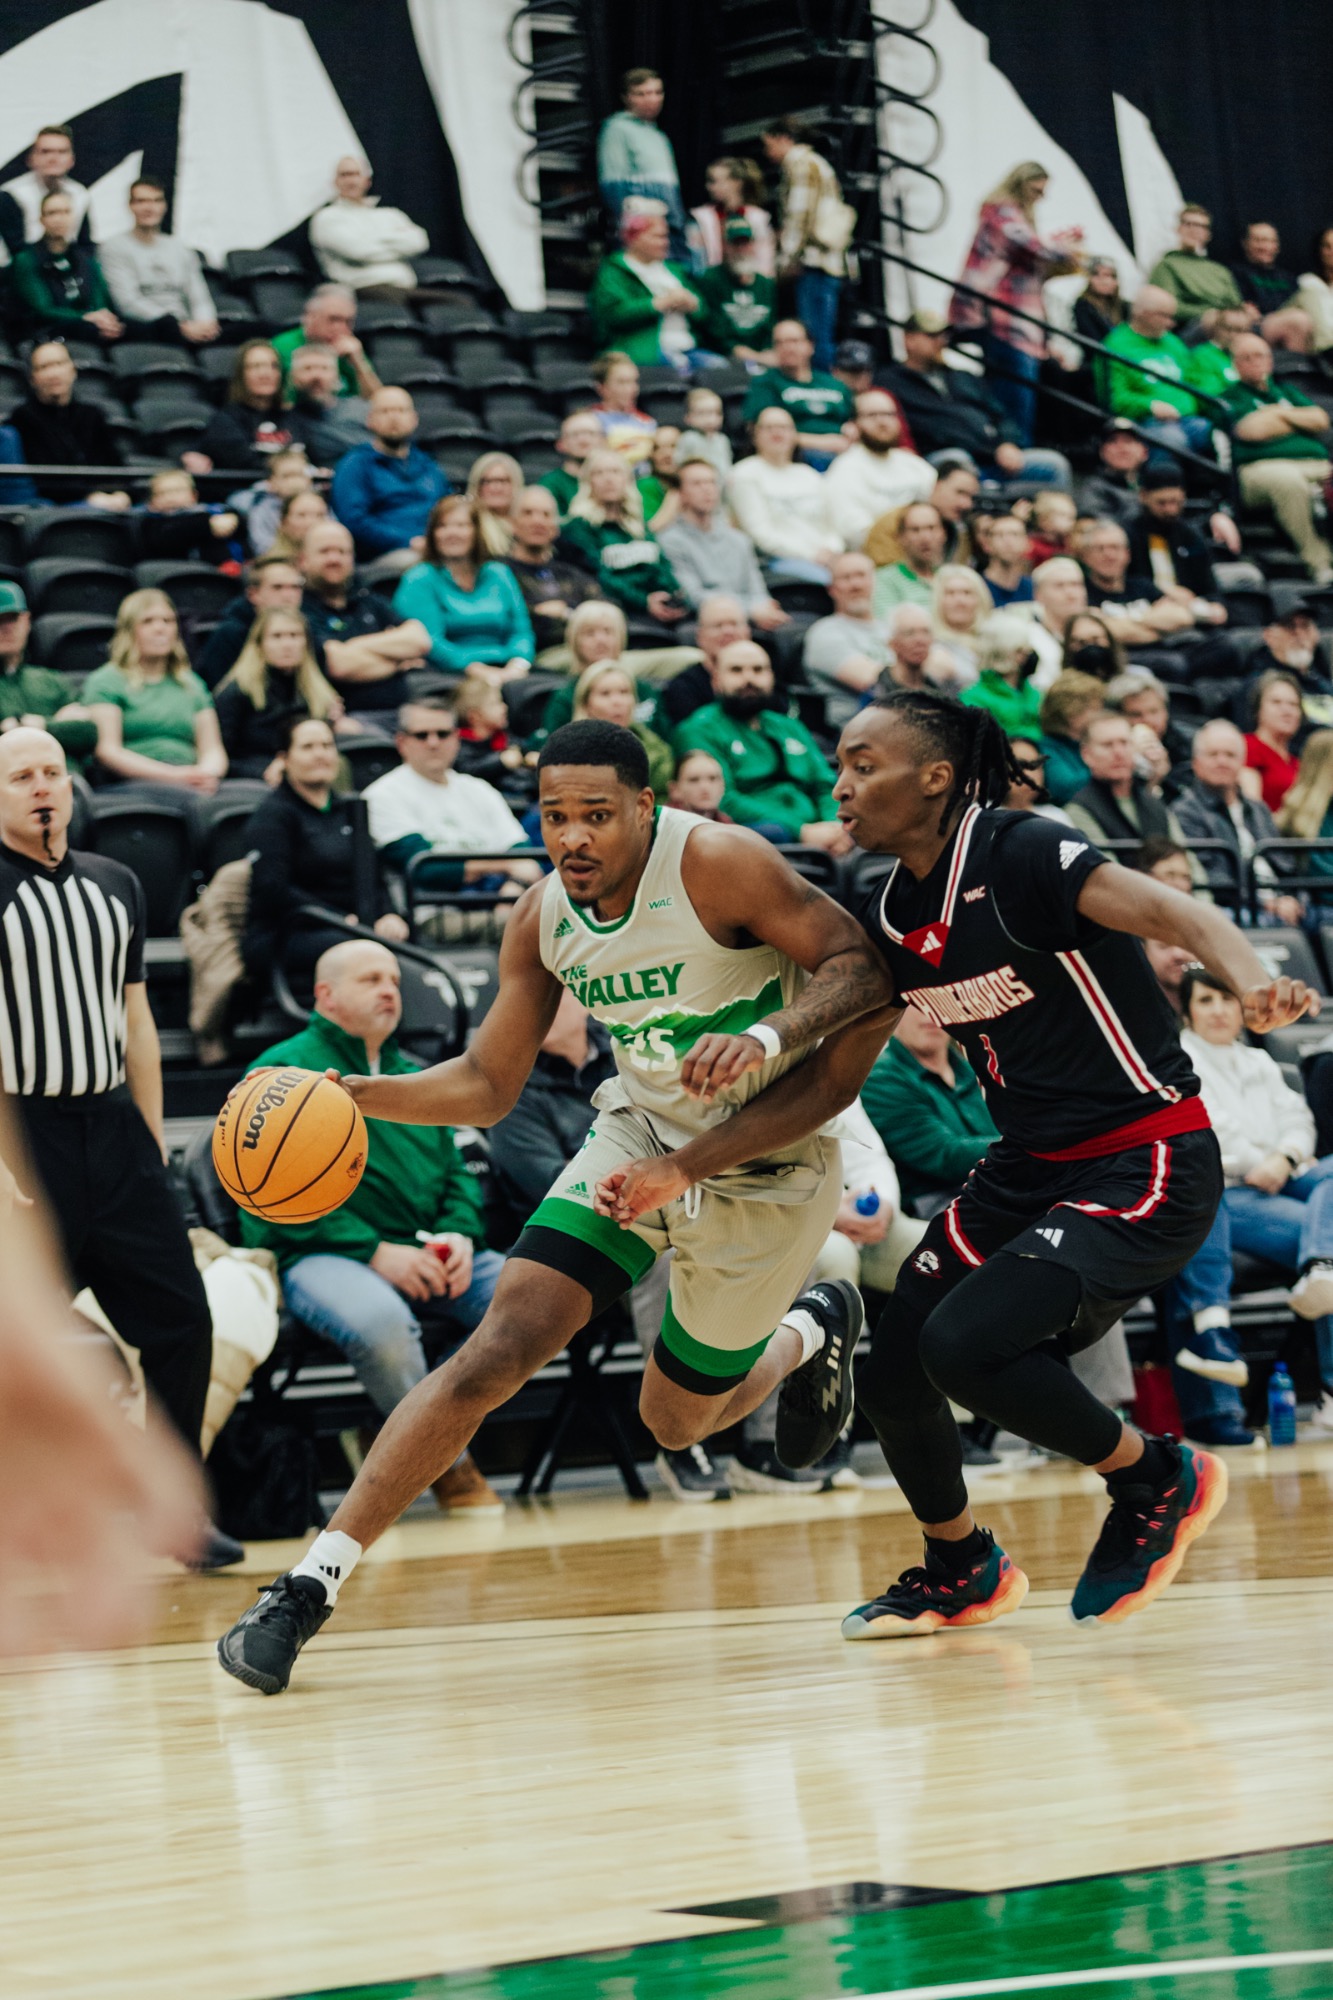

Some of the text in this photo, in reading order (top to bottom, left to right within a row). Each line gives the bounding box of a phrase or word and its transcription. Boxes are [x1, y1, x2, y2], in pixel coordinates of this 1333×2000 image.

[963, 885, 986, 903] WAC
[648, 897, 672, 910] WAC
[560, 964, 588, 982] THE
[566, 962, 686, 1008] VALLEY
[242, 1071, 310, 1151] Wilson
[565, 1188, 589, 1199] adidas
